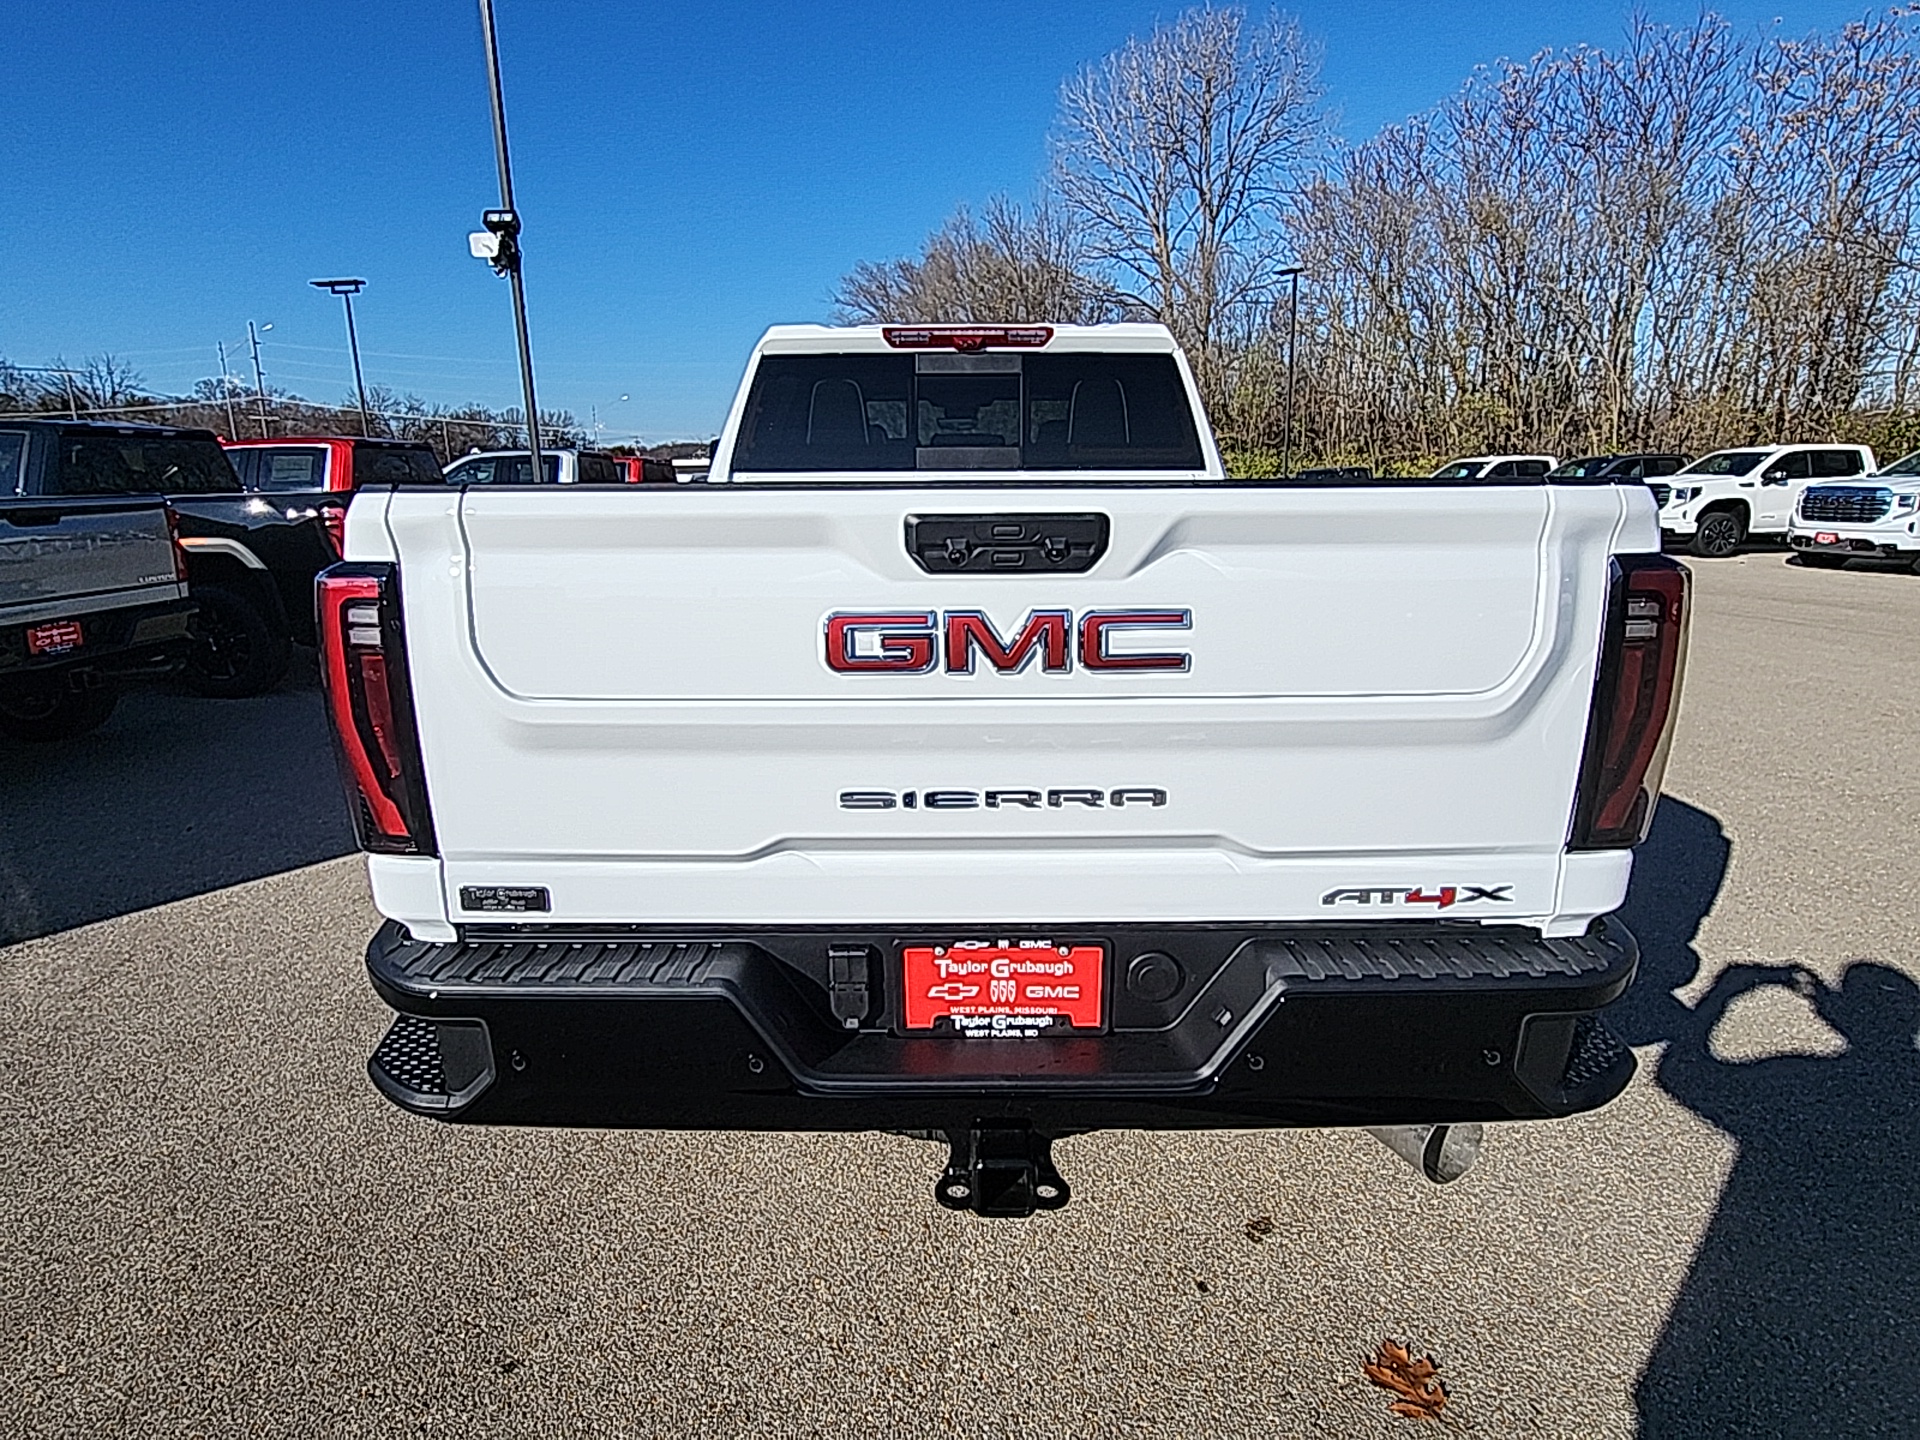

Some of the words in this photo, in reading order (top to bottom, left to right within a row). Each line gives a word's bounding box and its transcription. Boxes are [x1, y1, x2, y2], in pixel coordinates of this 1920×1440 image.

[823, 609, 1193, 677] GMC
[839, 788, 1168, 809] SIERRA
[1321, 885, 1514, 909] AT4X
[1019, 940, 1052, 949] GMC
[934, 959, 989, 978] Taylor
[990, 958, 1074, 978] Grubaugh
[1025, 986, 1080, 998] GMC
[950, 1006, 977, 1014] WEST
[1014, 1006, 1058, 1014] MISSOURI
[950, 1015, 991, 1030] Taylor
[992, 1014, 1053, 1029] Grubaugh
[965, 1029, 990, 1037] WEST
